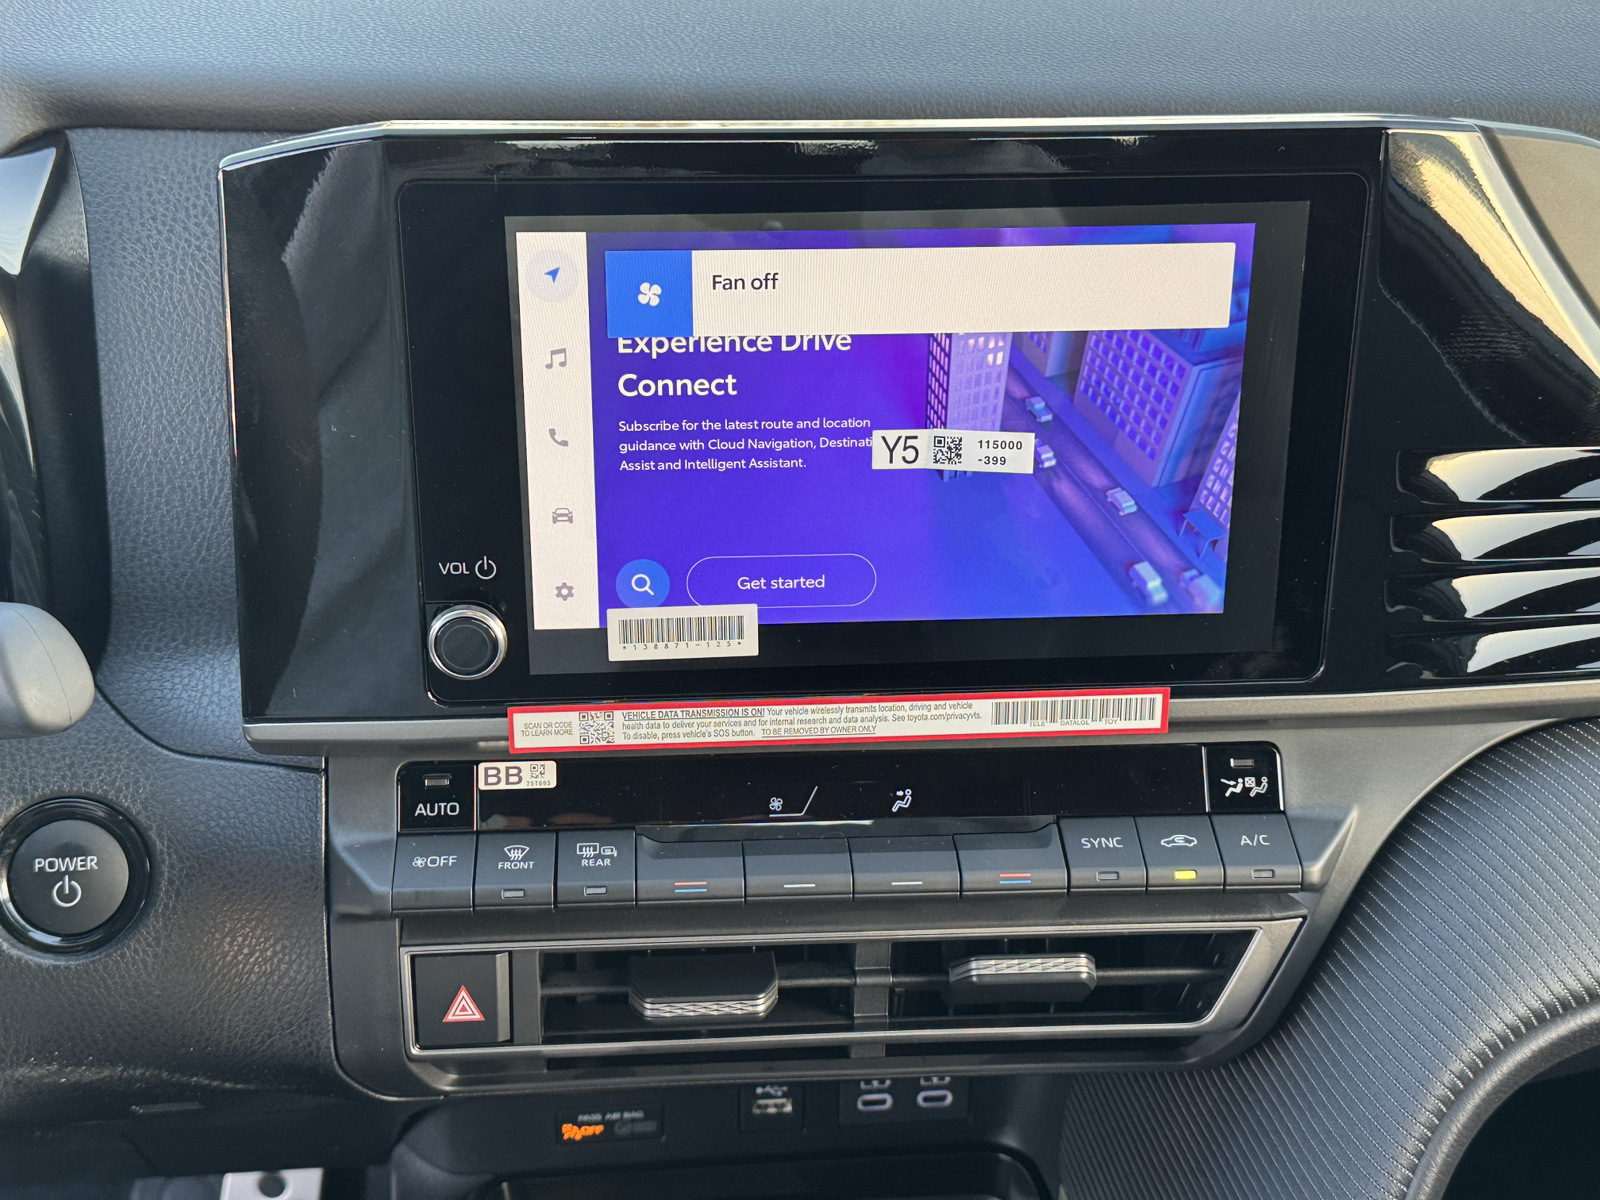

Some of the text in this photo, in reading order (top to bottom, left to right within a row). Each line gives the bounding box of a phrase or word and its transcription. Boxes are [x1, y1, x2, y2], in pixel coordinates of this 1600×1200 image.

[712, 272, 778, 290] Fan off
[618, 334, 852, 359] Experience Drive
[618, 374, 738, 396] Connect
[618, 418, 871, 432] Subscribe for the latest route and location
[619, 436, 872, 454] guidance with Cloud Navigation, Destinati
[880, 435, 919, 464] Y5
[978, 440, 1023, 450] 115000
[620, 458, 806, 472] Assist and Intelligent Assistant.
[978, 456, 1006, 466] -399
[438, 562, 470, 575] VOL
[737, 574, 826, 590] Get started
[622, 710, 656, 720] VEHICLE
[658, 710, 678, 719] DATA
[680, 708, 740, 718] TRANSMISSION
[742, 708, 749, 716] IS
[767, 707, 782, 716] Your
[785, 706, 808, 716] vehicle
[810, 706, 844, 715] wirelessly
[846, 704, 876, 714] transmits
[878, 704, 907, 712] location,
[908, 703, 932, 712] driving
[934, 702, 946, 710] and
[948, 702, 972, 710] vehicle
[622, 722, 644, 730] health
[646, 722, 660, 730] data
[662, 721, 670, 729] to
[672, 720, 694, 729] deliver
[696, 721, 711, 730] your
[713, 720, 742, 728] services
[744, 718, 756, 727] and
[758, 718, 768, 726] for
[770, 717, 795, 726] internal
[796, 716, 826, 725] research
[828, 716, 842, 724] and
[843, 716, 858, 724] data
[860, 714, 890, 724] analysis.
[892, 714, 906, 722] See
[622, 732, 631, 740] To
[632, 730, 660, 740] disable,
[662, 731, 680, 740] press
[682, 730, 712, 738] vehicle's
[713, 729, 730, 738] SOS
[732, 728, 756, 738] button.
[772, 728, 782, 736] BE
[784, 727, 818, 735] REMOVED
[484, 766, 522, 786] BB
[414, 802, 460, 816] AUTO
[1081, 837, 1124, 848] SYNC
[1240, 834, 1270, 846] A/C
[34, 856, 98, 872] POWER
[427, 856, 458, 868] OFF
[498, 862, 534, 870] FRONT
[582, 858, 611, 867] REAR
